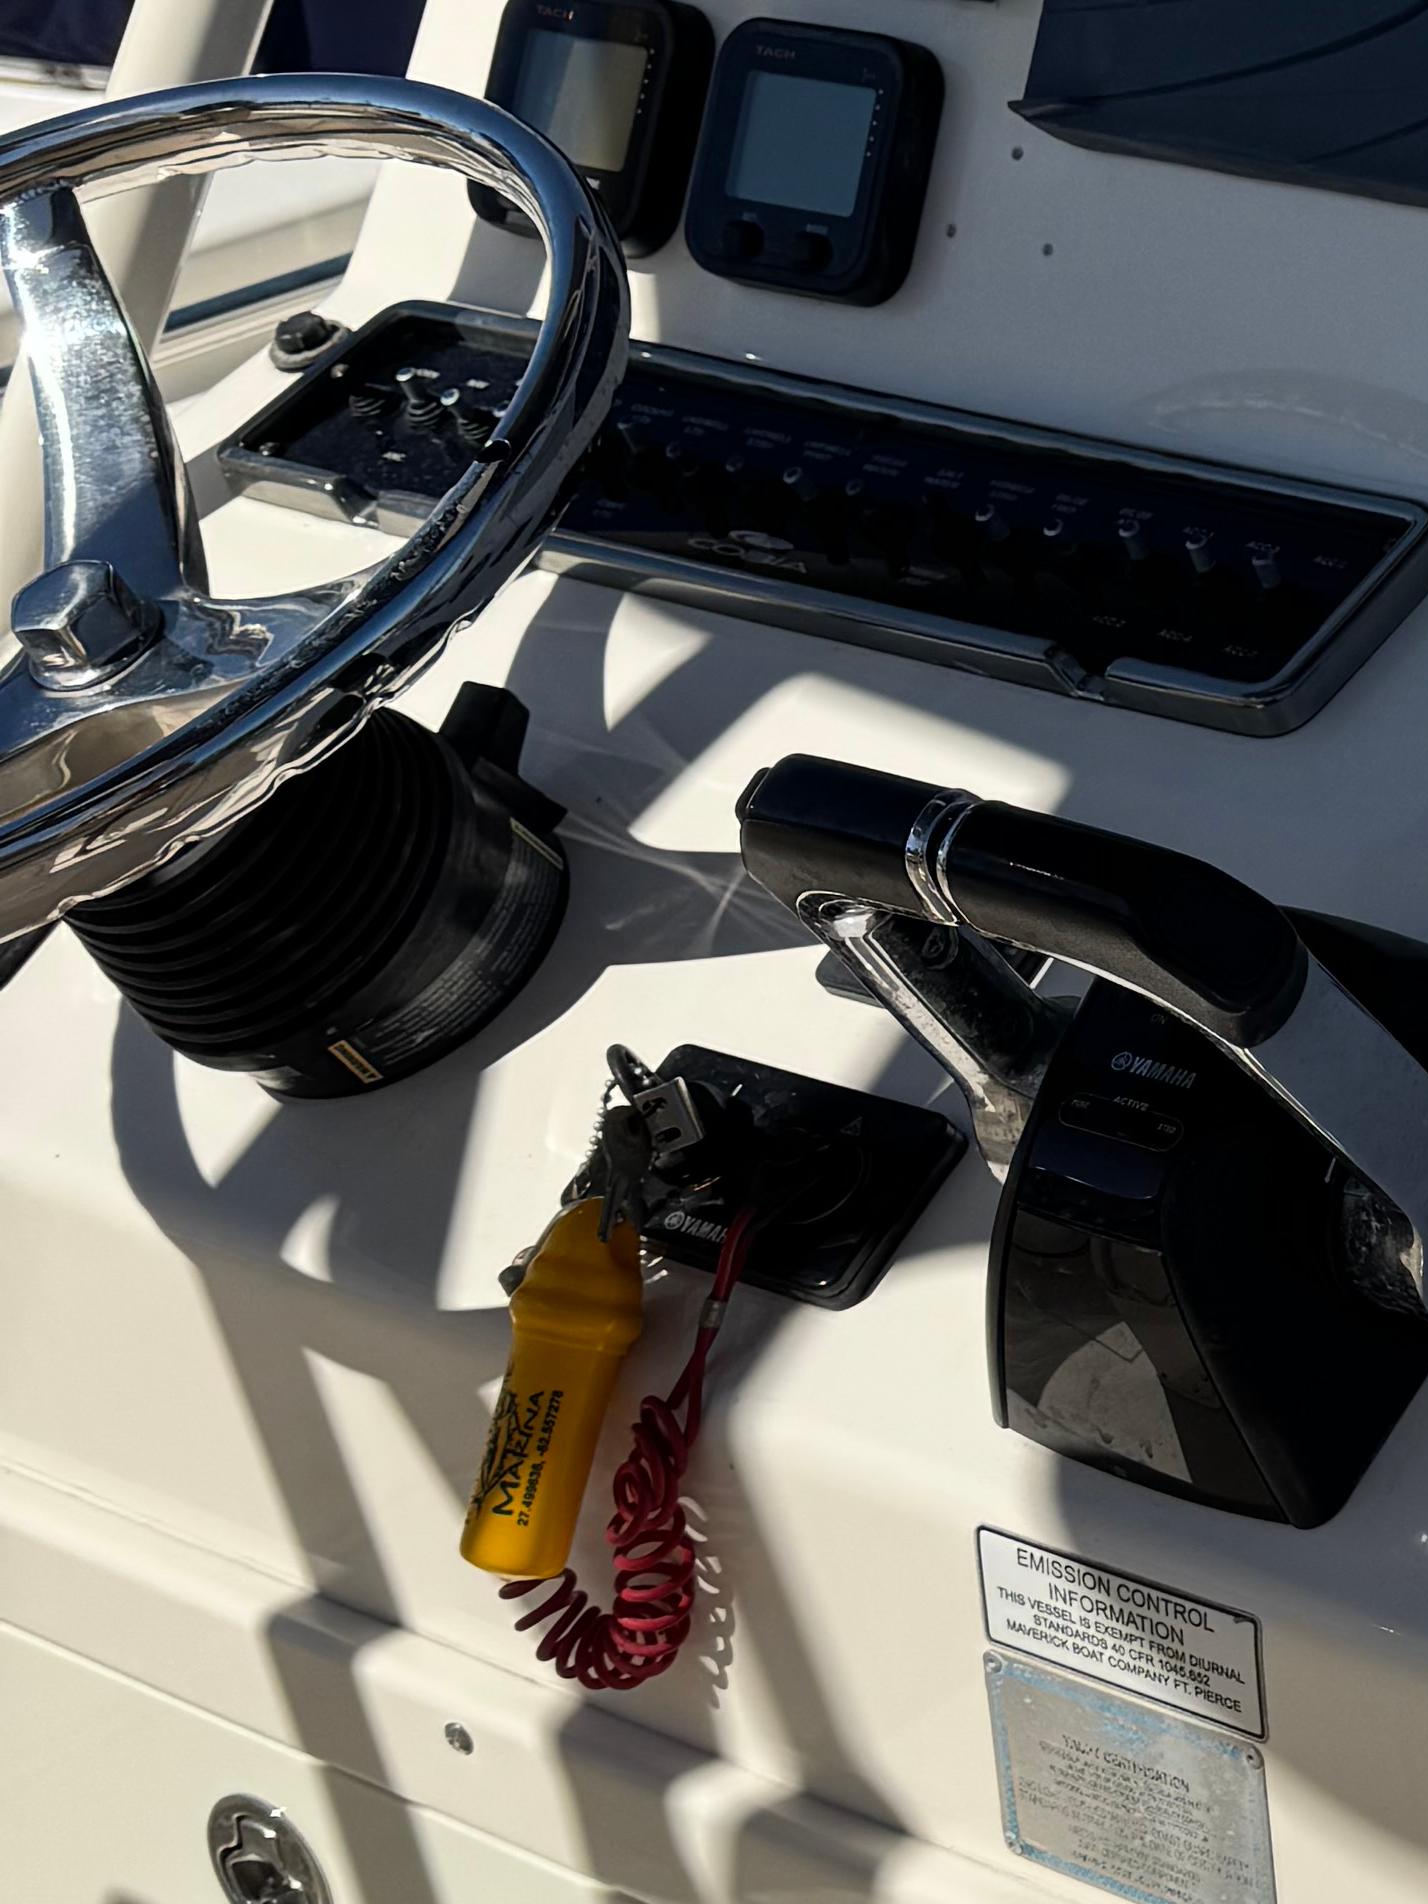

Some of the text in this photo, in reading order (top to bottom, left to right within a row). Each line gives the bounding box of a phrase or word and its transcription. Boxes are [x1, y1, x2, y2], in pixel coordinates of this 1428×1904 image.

[755, 43, 797, 61] TACH
[1128, 1055, 1198, 1089] YAMAHA
[1016, 1547, 1215, 1633] EMISSION CONTROL
[1048, 1582, 1185, 1647] INFORMATION
[996, 1585, 1246, 1685] THIS VESSEL IS EXEMPT FROM DIURNAL
[1006, 1617, 1243, 1714] MAVERICK BOAT COMPANY FT. PIERCE
[1033, 1614, 1109, 1650] STANDARDS
[1111, 1642, 1125, 1657] 40
[1128, 1648, 1155, 1668] CFR
